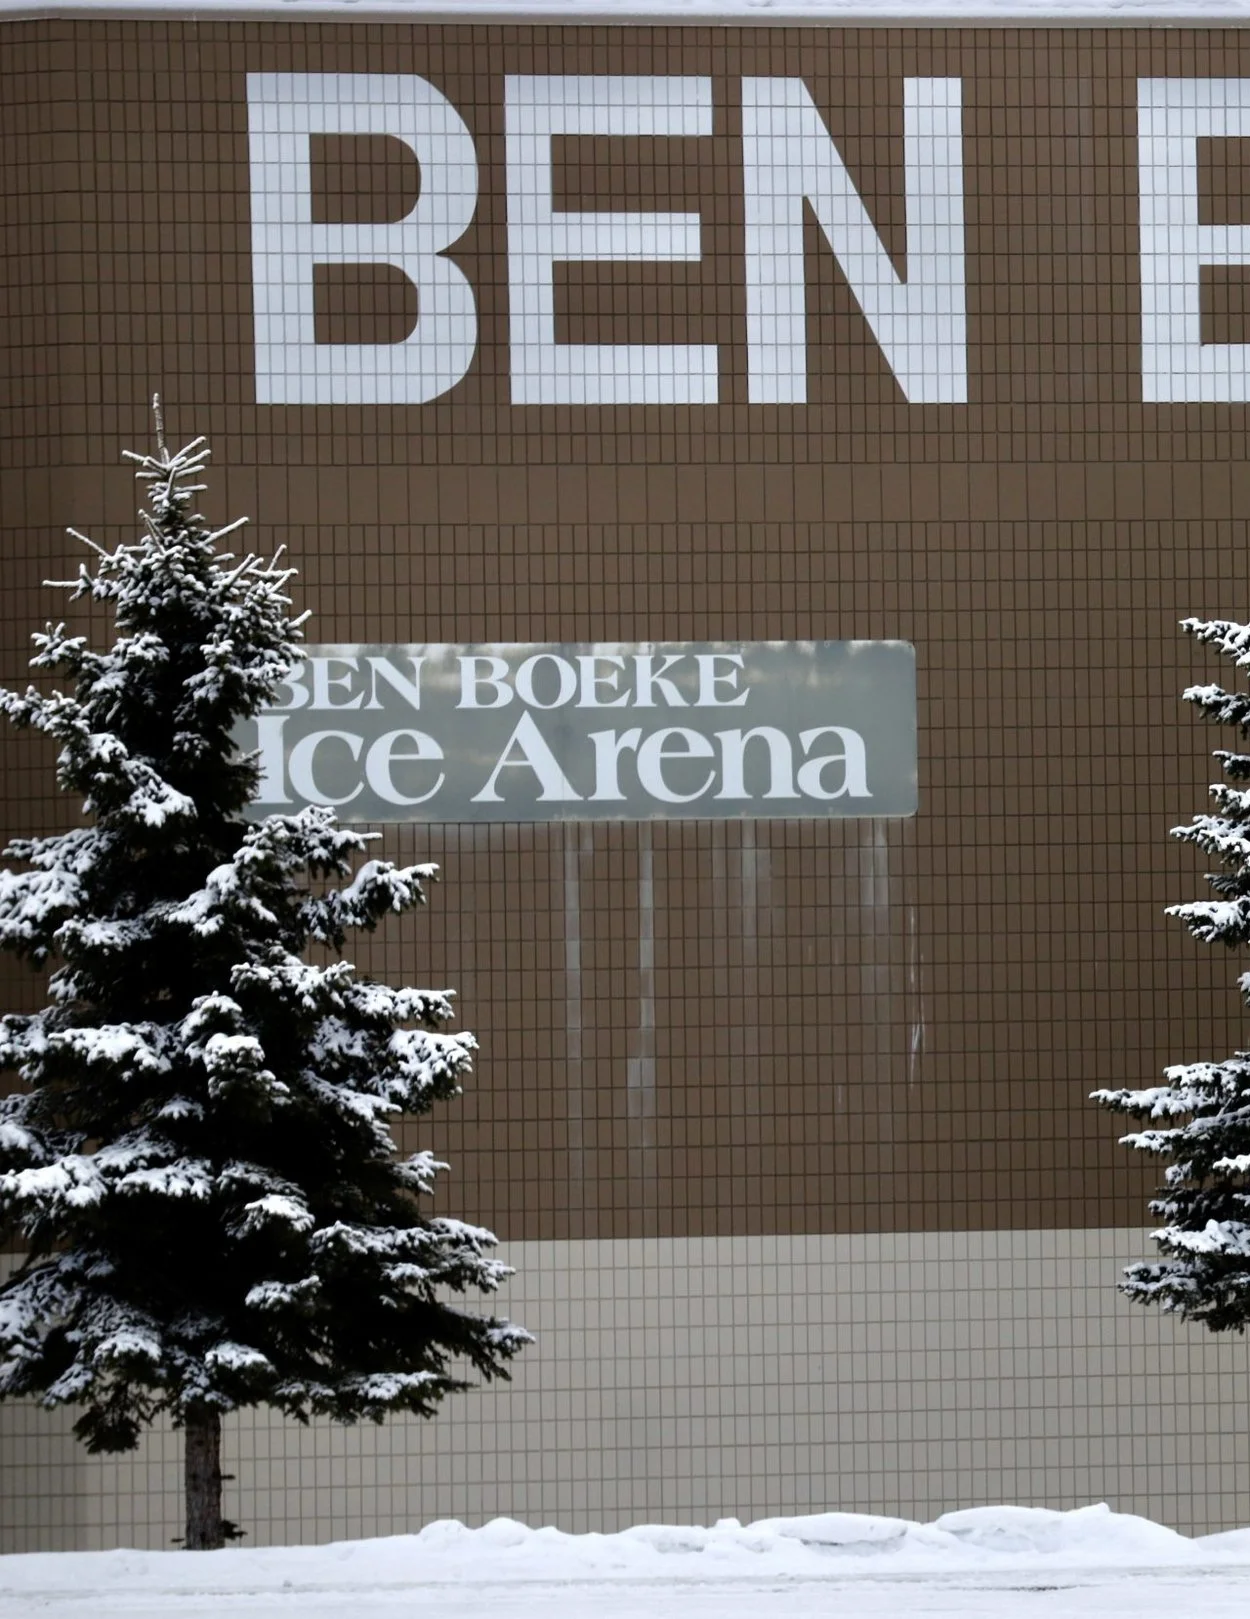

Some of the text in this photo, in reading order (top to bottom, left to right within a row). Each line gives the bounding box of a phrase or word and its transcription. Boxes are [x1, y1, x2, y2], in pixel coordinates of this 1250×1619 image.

[246, 72, 968, 404] BEN
[455, 653, 751, 710] BOEKE
[251, 709, 874, 806] Ice Arena
